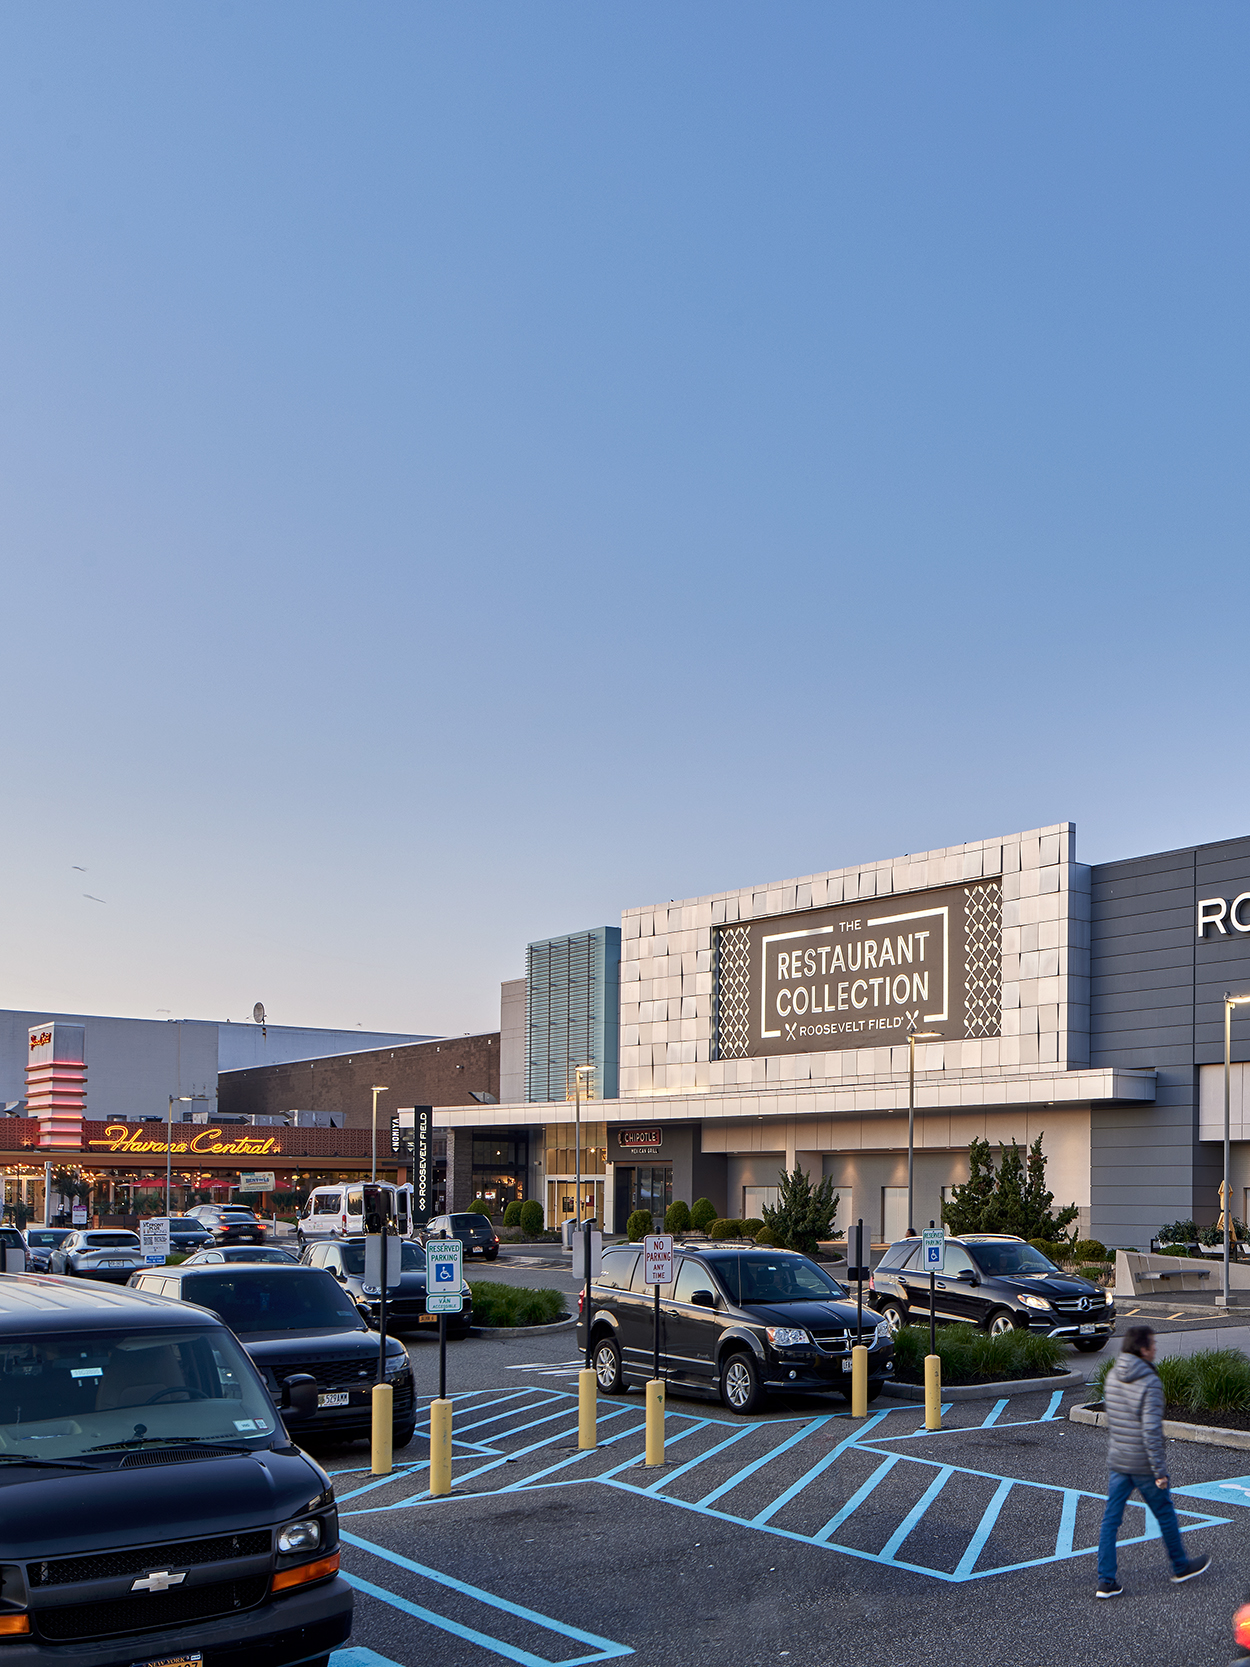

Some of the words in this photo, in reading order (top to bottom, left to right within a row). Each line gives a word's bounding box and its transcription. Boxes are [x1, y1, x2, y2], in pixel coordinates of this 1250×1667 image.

[839, 919, 861, 932] THE
[777, 931, 930, 981] RESTAURANT
[776, 971, 929, 1017] COLLECTION
[800, 1020, 865, 1037] ROOSEVELT
[869, 1017, 902, 1030] FIELD
[419, 1112, 427, 1140] FIELD
[89, 1125, 188, 1152] Havana
[190, 1128, 276, 1154] Central
[624, 1132, 656, 1142] CHIPOTLE
[419, 1141, 427, 1197] ROOSEVELT
[428, 1245, 460, 1253] RESERVED
[653, 1240, 665, 1250] NO
[646, 1252, 671, 1261] PARKING
[653, 1263, 665, 1271] ANY
